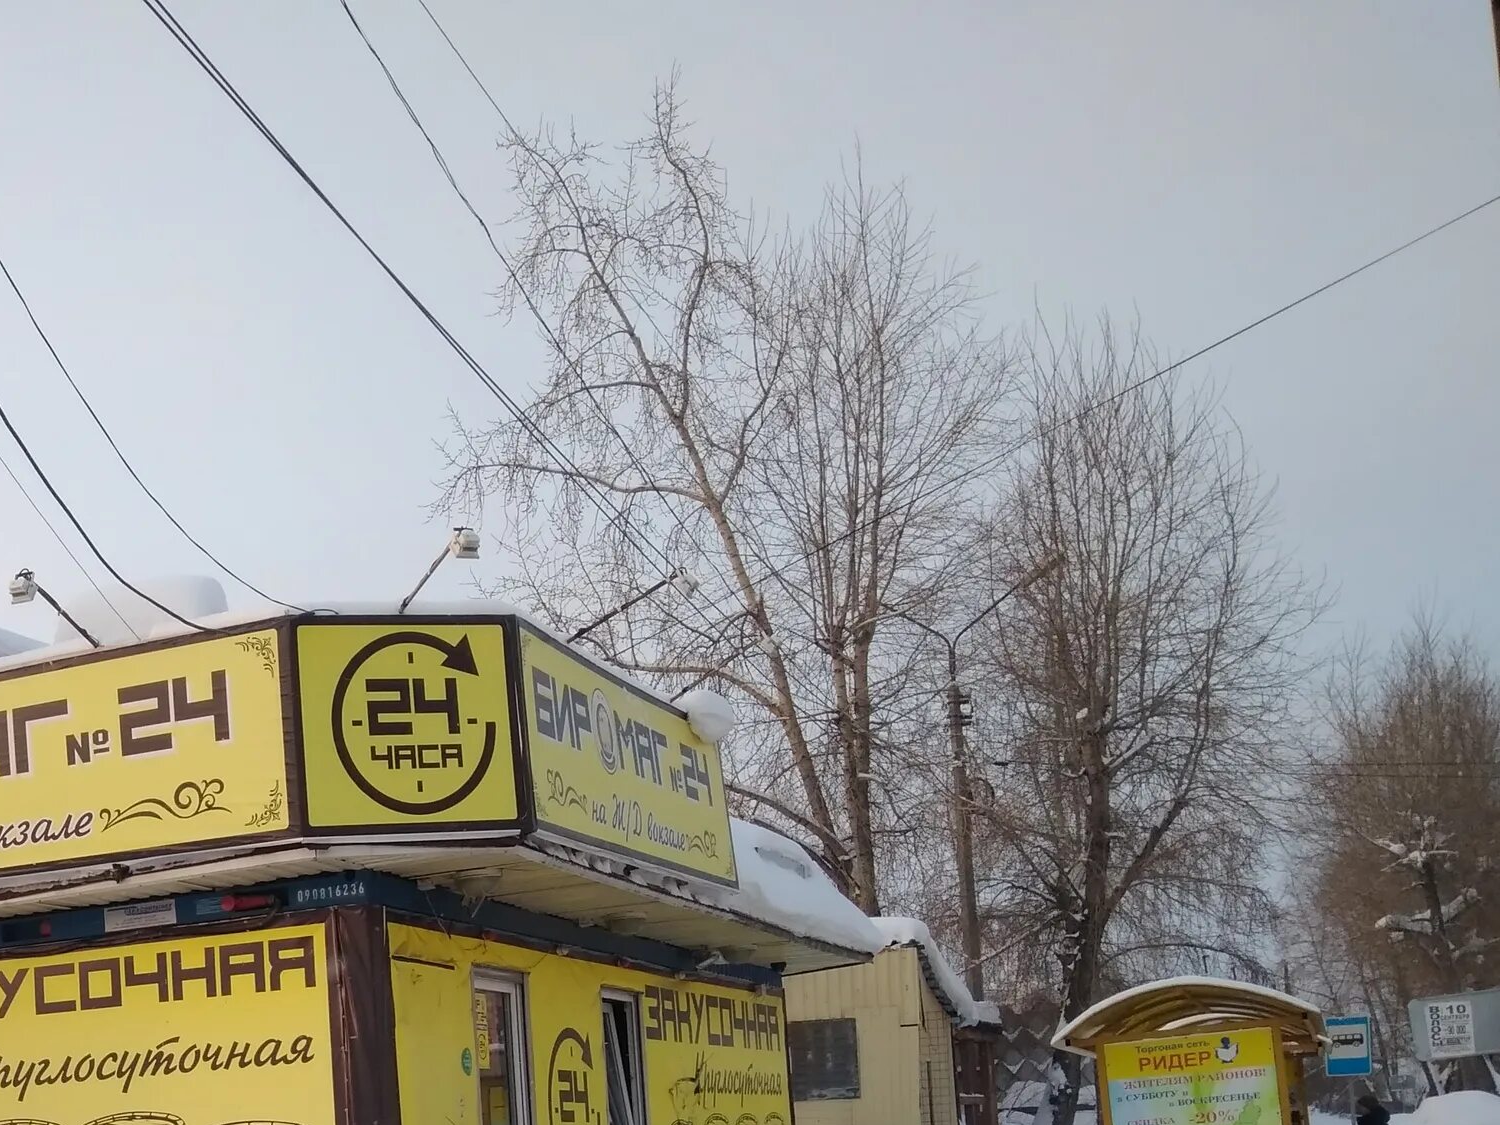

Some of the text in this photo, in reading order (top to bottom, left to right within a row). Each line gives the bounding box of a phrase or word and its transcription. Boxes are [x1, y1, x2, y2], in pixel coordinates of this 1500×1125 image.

[118, 670, 231, 757] 24
[365, 677, 461, 736] 24
[370, 743, 463, 769] ЧАСА
[591, 793, 686, 851] на Ж/Д вокзале
[644, 985, 781, 1052] ЗАКУСОЧНАЯ
[1135, 1040, 1211, 1054] Торговая сеть
[1139, 1051, 1211, 1072] РИДЕР
[558, 1070, 590, 1123] 24
[695, 1051, 782, 1109] Круглосуточная
[1124, 1076, 1193, 1090] ЖИТЕЛЯМ
[1126, 1090, 1179, 1102] СУББОТУ
[1178, 1092, 1261, 1107] ВОСКРЕСЕНЬЕ
